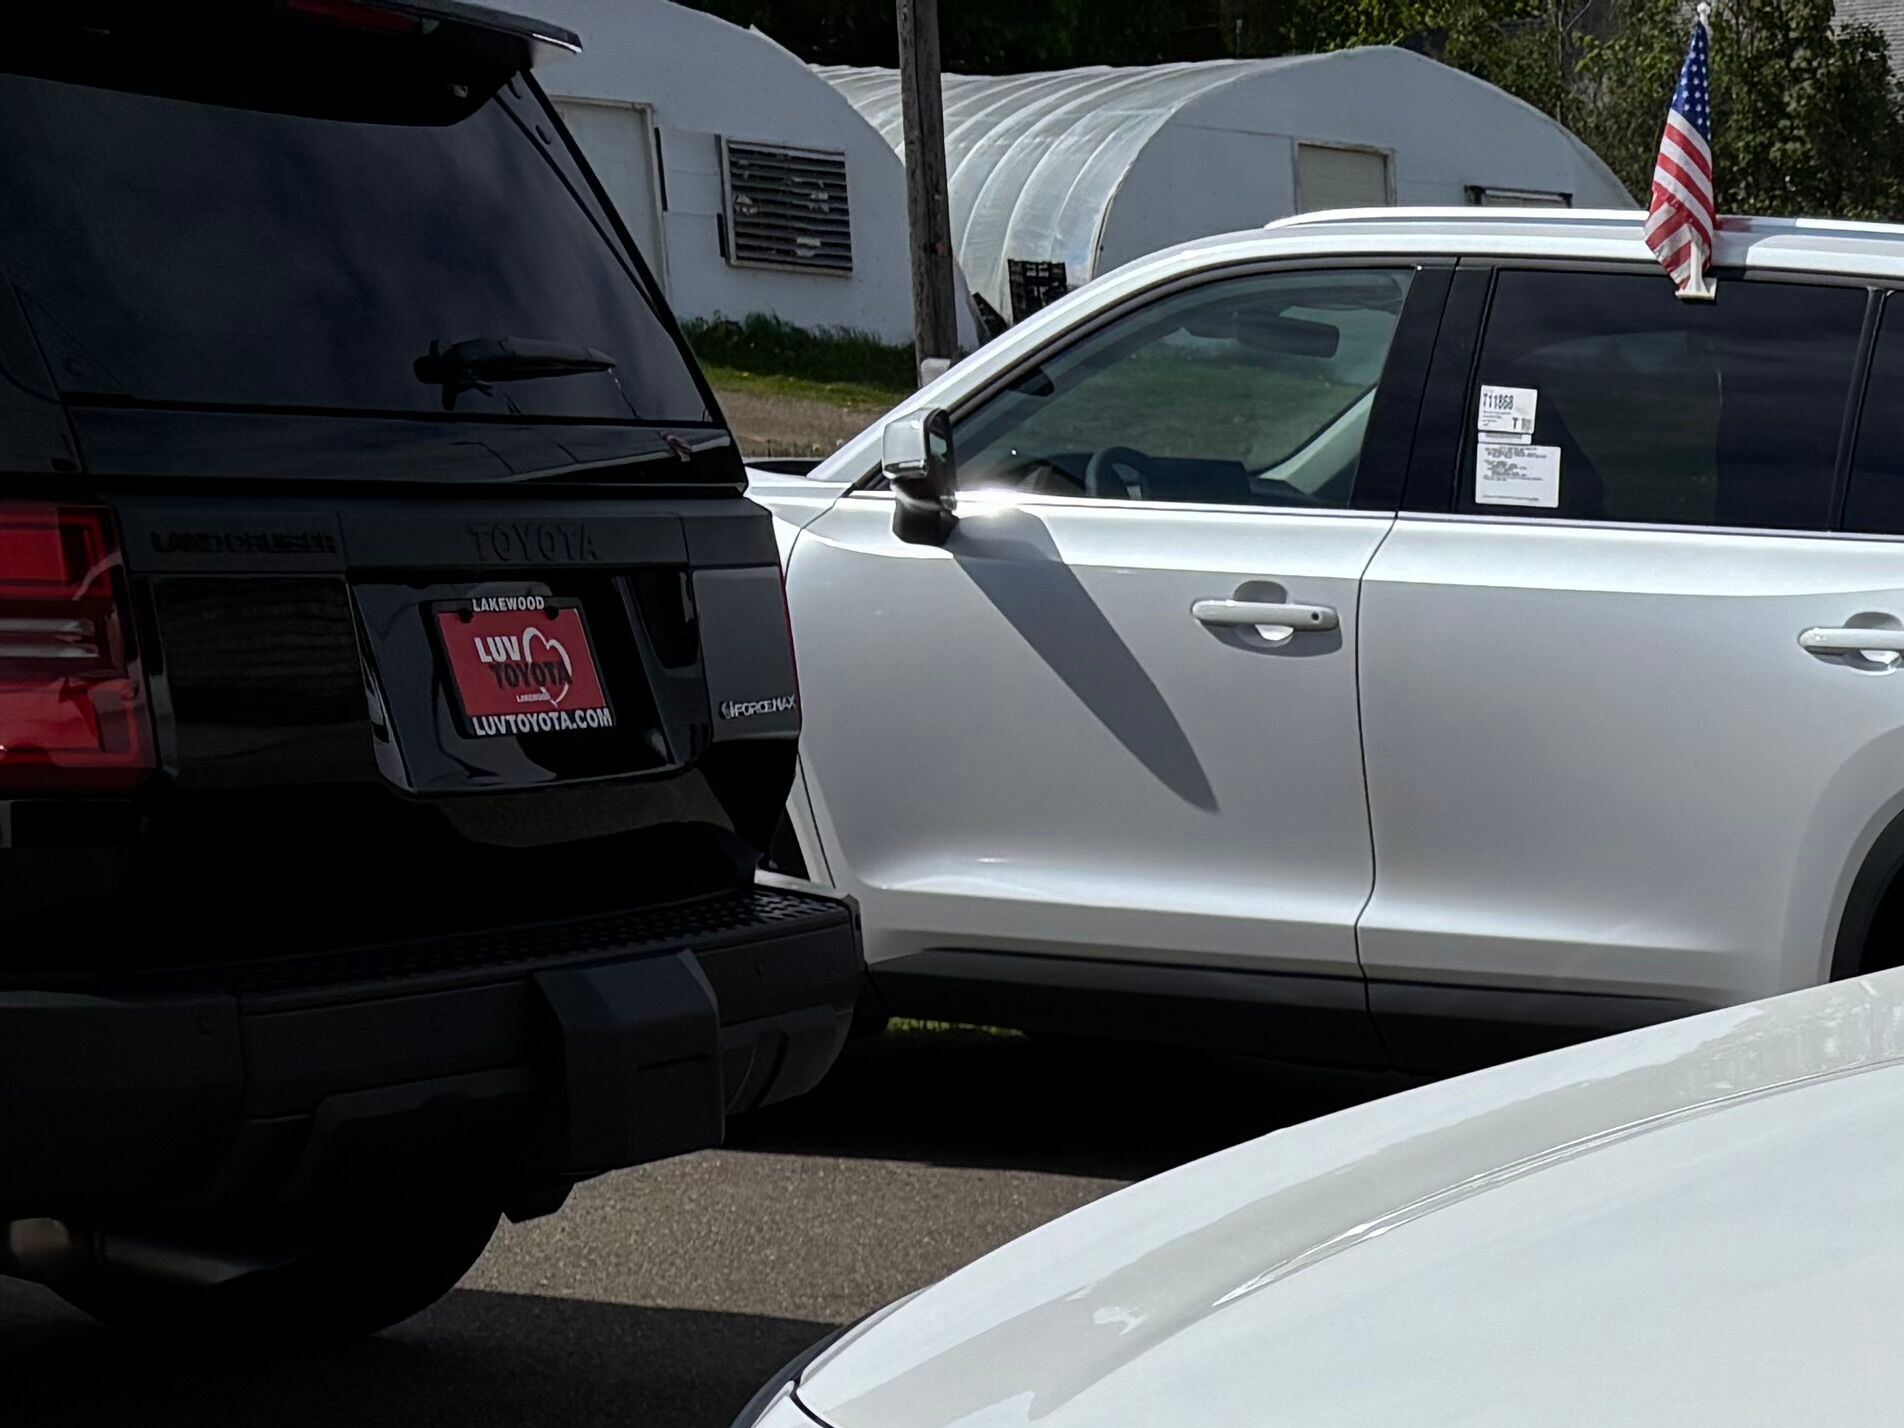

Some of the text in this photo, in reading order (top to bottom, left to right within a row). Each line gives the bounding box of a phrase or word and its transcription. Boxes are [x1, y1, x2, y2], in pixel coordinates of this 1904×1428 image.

[468, 522, 598, 562] TOYOTA
[472, 596, 545, 612] LAKEWOOD
[474, 636, 523, 663] LUV
[490, 661, 573, 690] TOYOTA
[472, 708, 613, 737] LUVTOYOTA.COM
